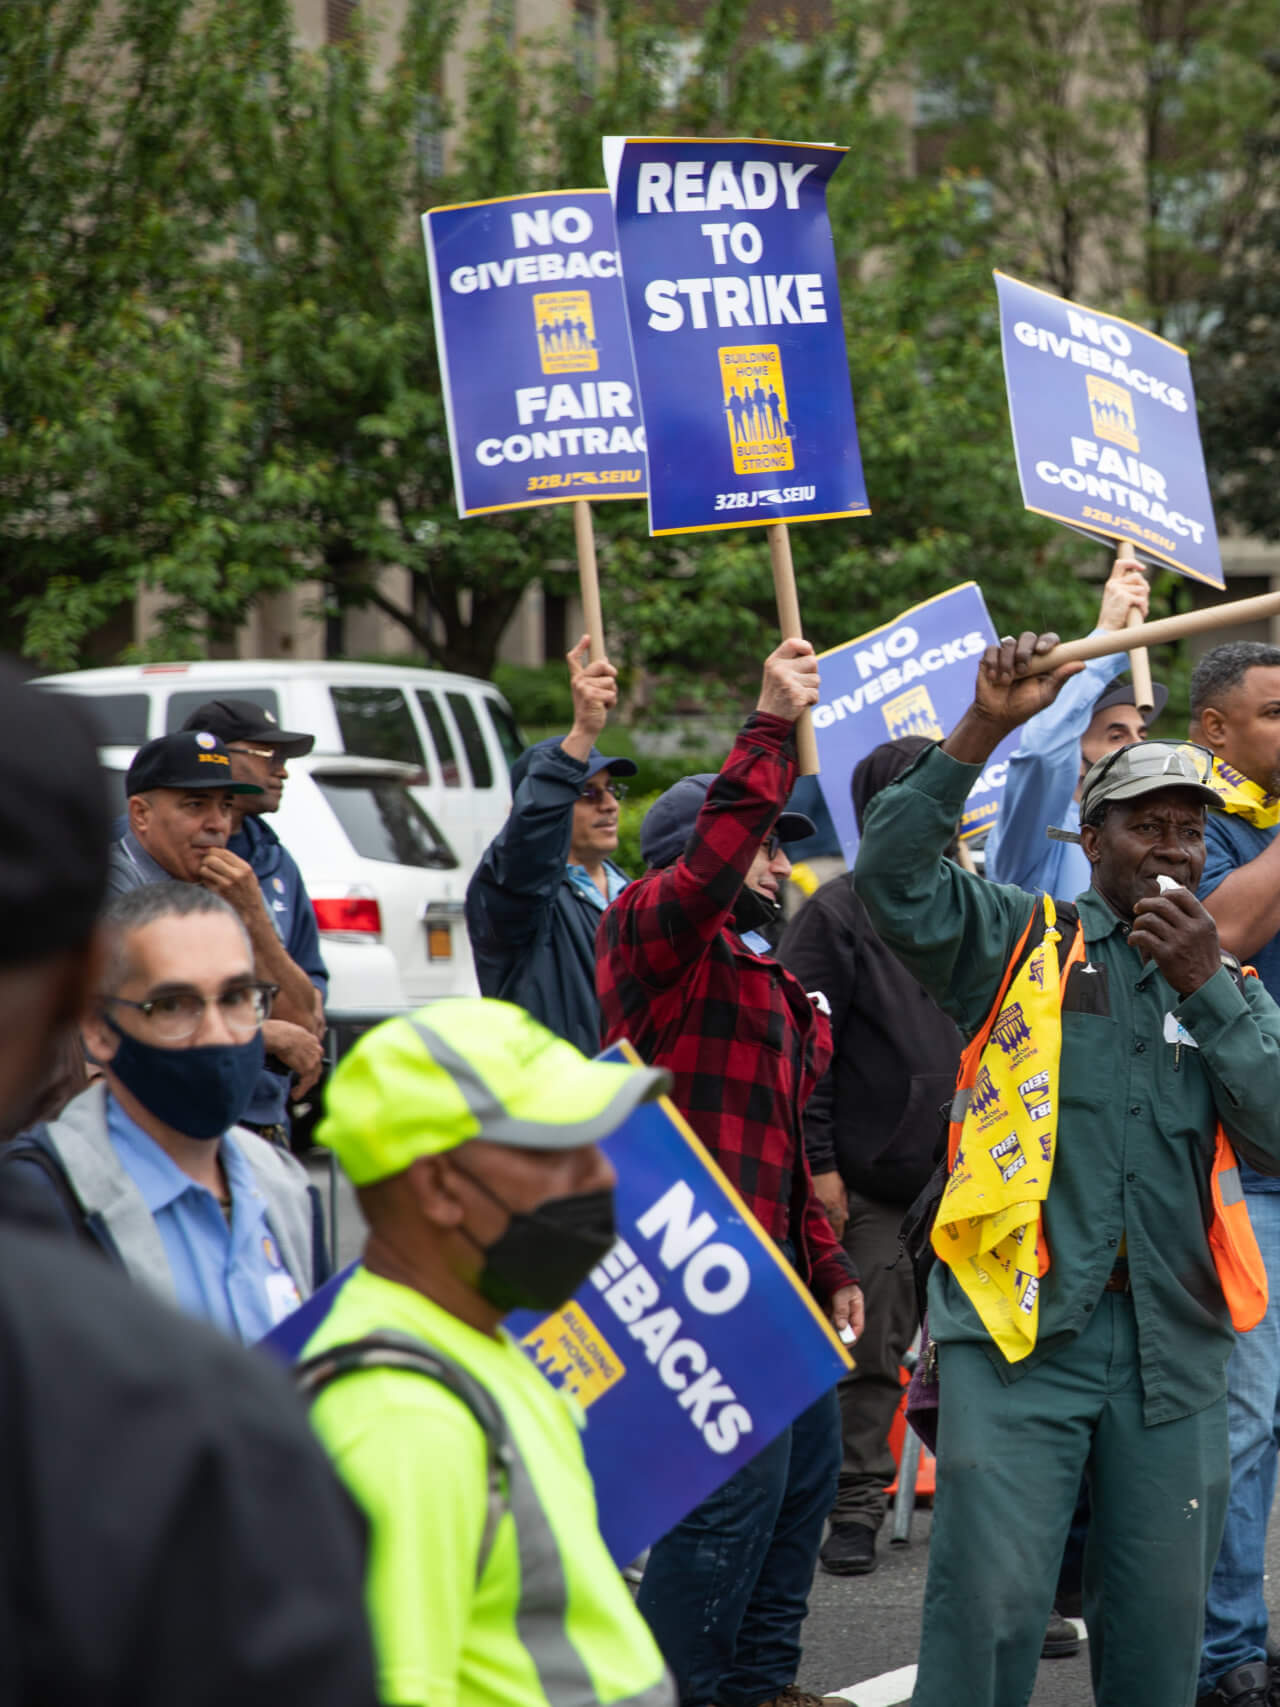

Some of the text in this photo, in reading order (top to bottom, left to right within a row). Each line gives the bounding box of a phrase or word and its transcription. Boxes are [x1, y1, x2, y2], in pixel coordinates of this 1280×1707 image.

[637, 161, 819, 214] READY
[511, 206, 593, 249] NO
[701, 222, 764, 265] TO
[644, 273, 828, 332] STRIKE
[1067, 310, 1133, 356] NO
[724, 352, 777, 365] BUILDING
[736, 365, 769, 377] HOME
[1013, 321, 1188, 413] GIVEBACKS
[515, 381, 635, 426] FAIR
[475, 425, 648, 467] CONTRAC
[736, 442, 788, 457] BUILDING
[742, 456, 787, 471] STRONG
[527, 469, 641, 491] 32BJ SEIU
[1070, 436, 1169, 502] FAIR
[714, 485, 816, 511] 32BJ SEIU
[1034, 460, 1206, 546] CONTRACT
[854, 626, 919, 679] NO
[811, 630, 988, 729] GIVEBACKS
[990, 1130, 1017, 1159] SEIU
[636, 1179, 751, 1315] NO
[559, 1334, 594, 1379] HOME
[562, 1311, 616, 1379] BUILDING
[589, 1234, 753, 1454] EBACKS
